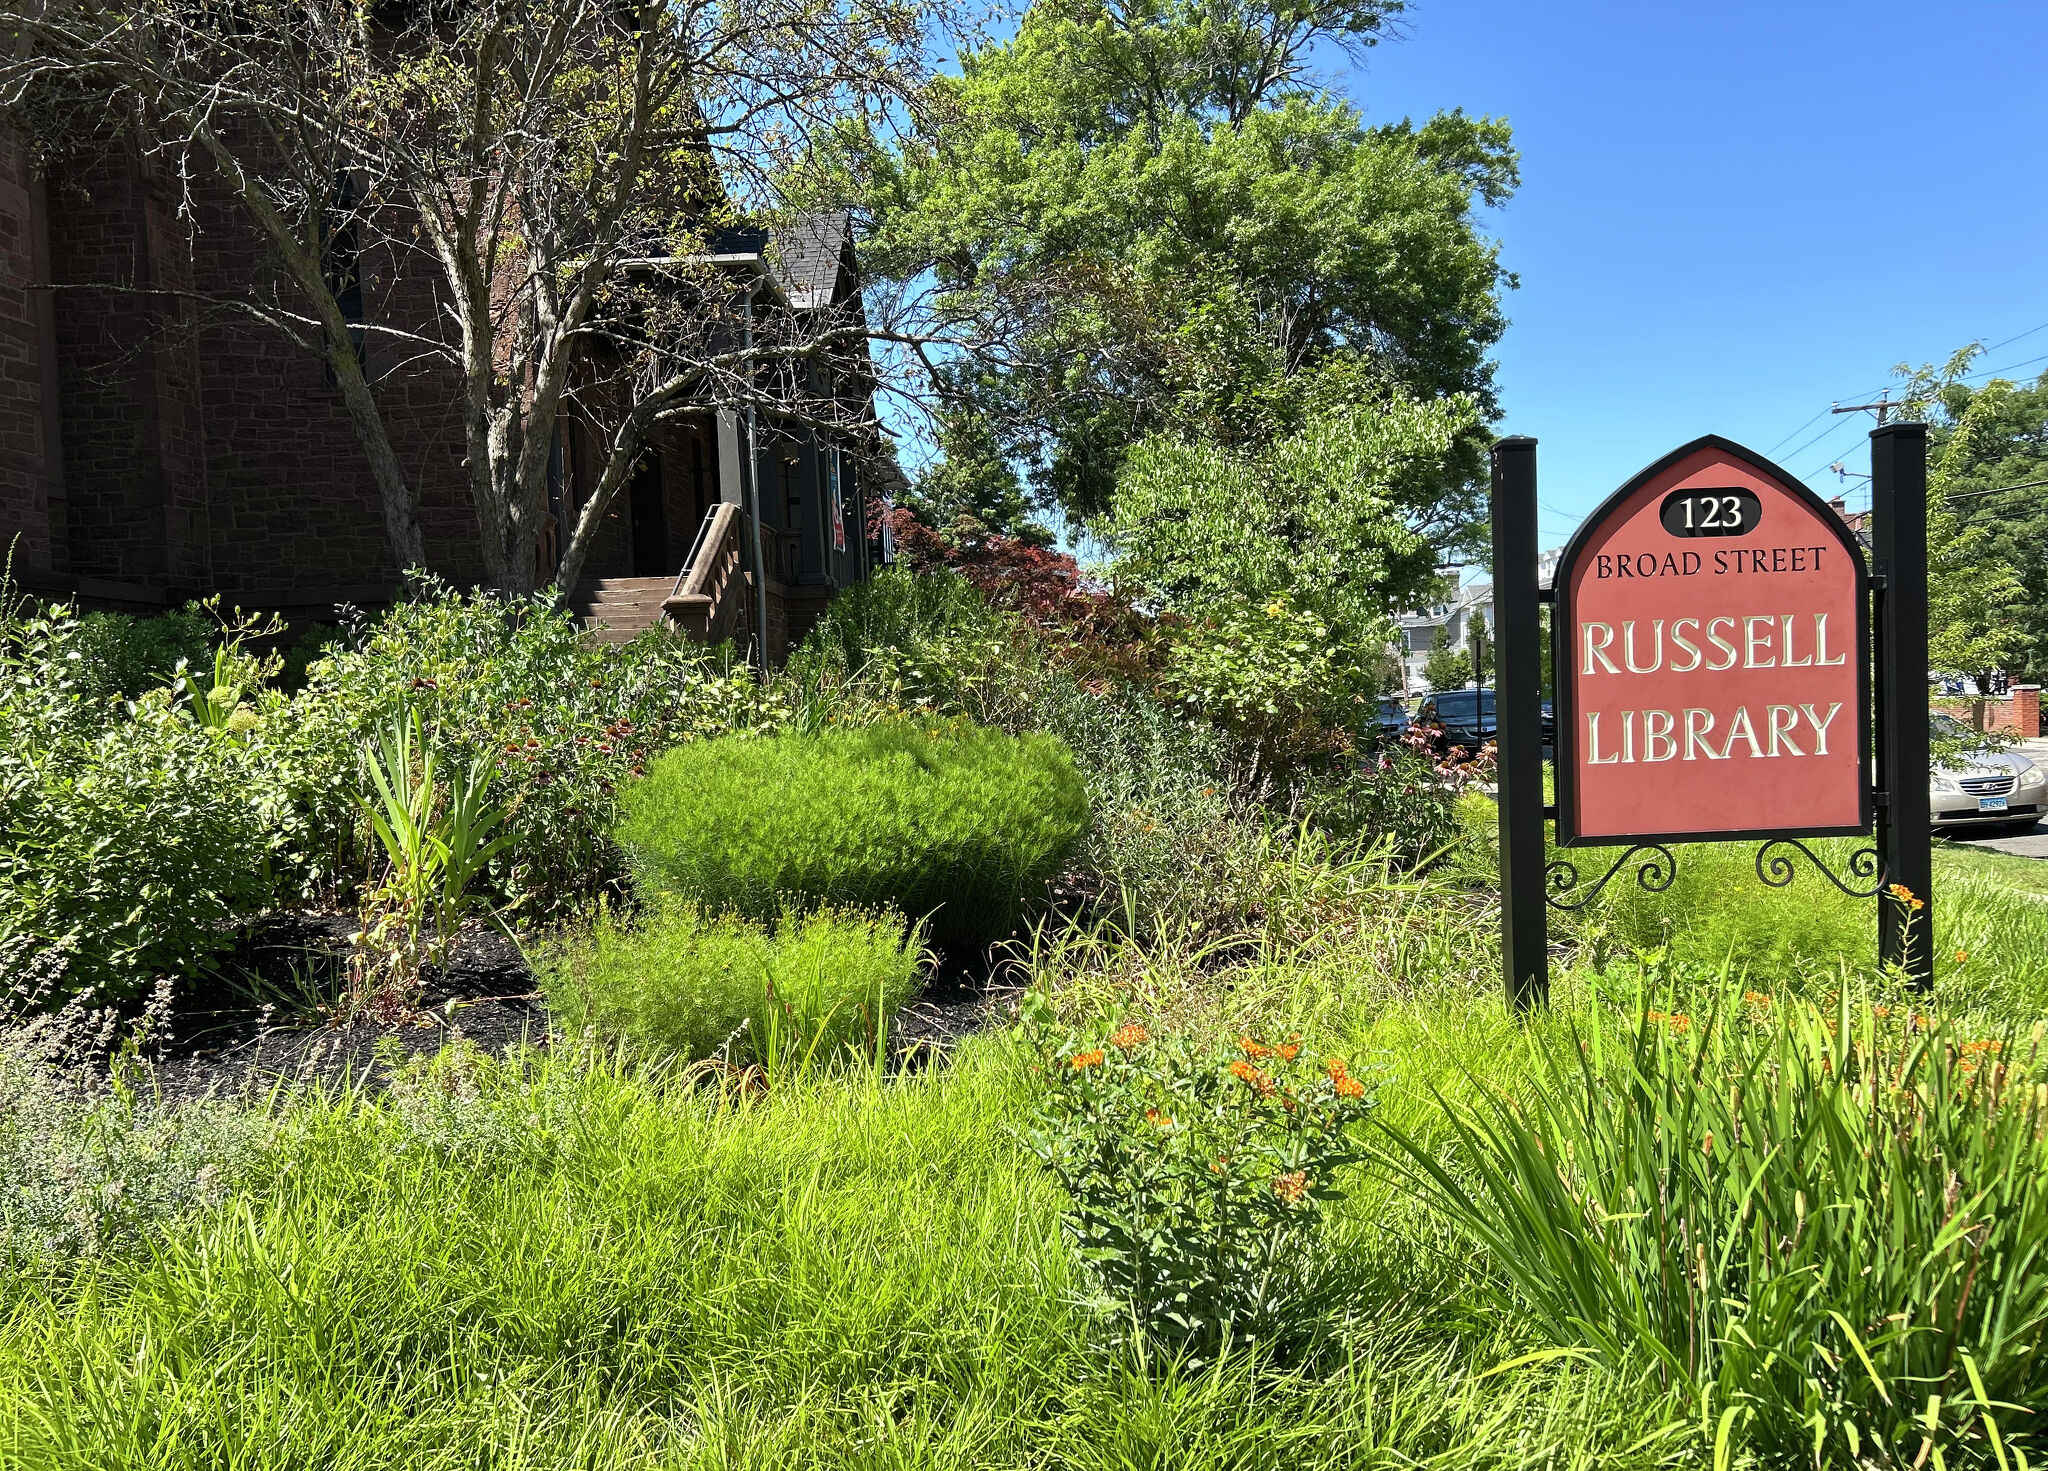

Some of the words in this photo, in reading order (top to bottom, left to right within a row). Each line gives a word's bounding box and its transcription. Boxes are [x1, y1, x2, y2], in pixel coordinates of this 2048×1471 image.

[1680, 497, 1742, 529] 123
[1597, 552, 1702, 579] BROAD
[1714, 547, 1826, 575] STREET
[1581, 613, 1846, 675] RUSSELL
[1586, 702, 1842, 765] LIBRARY
